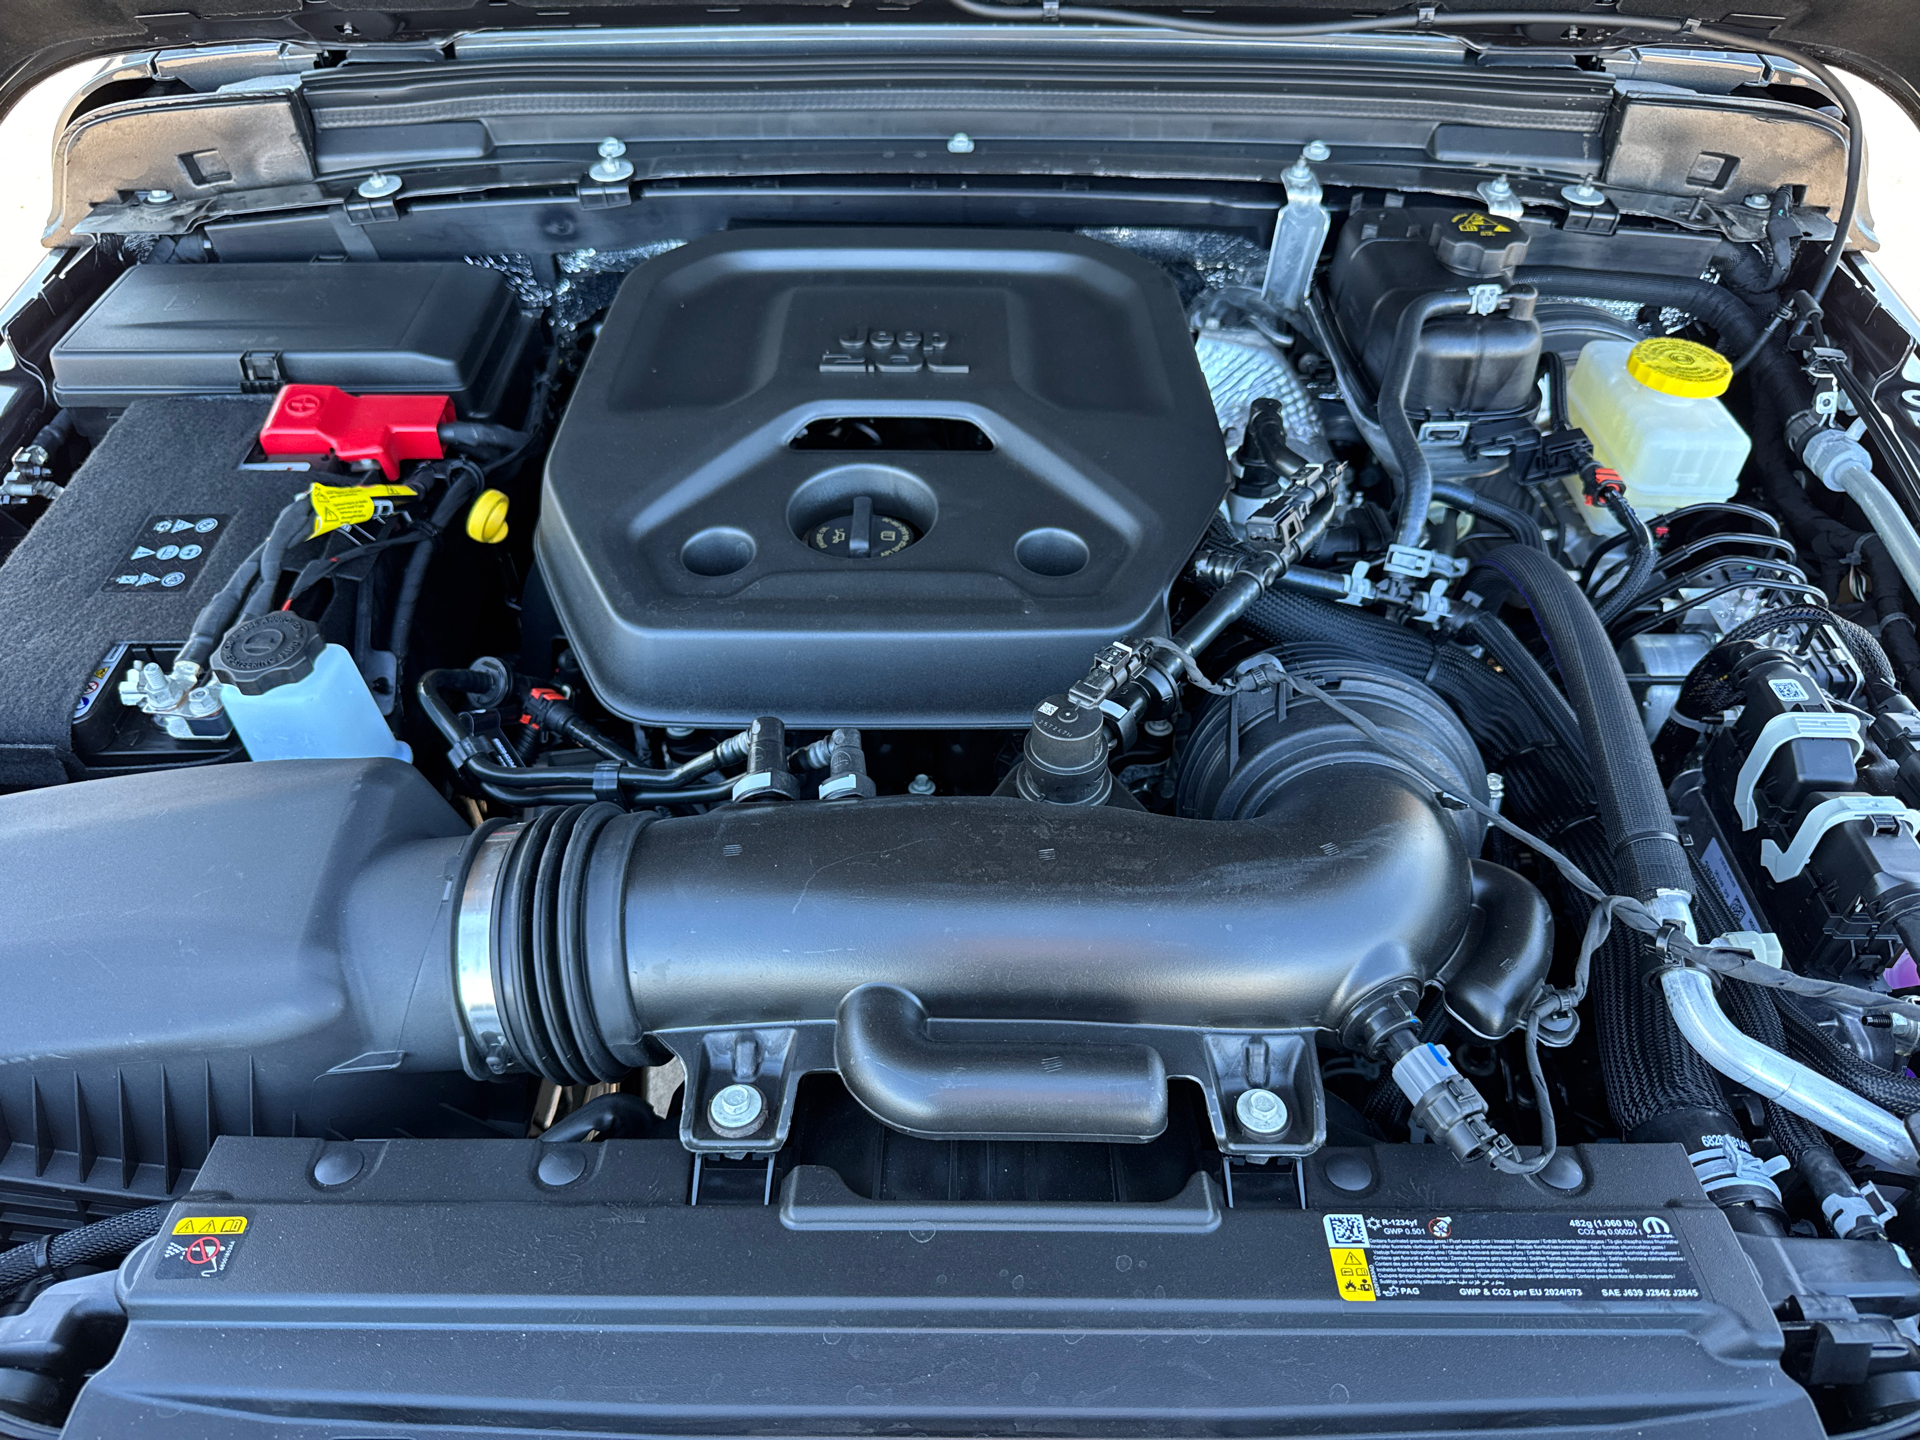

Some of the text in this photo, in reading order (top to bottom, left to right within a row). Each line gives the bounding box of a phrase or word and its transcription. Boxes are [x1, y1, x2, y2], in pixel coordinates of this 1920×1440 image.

[839, 325, 949, 353] Jeep
[819, 350, 970, 373] 2.0L
[262, 615, 303, 631] APPROVED
[1381, 1218, 1418, 1228] R-1234yf
[1569, 1219, 1638, 1229] 482g (1.060 lb)
[1577, 1228, 1595, 1236] CO2
[1596, 1229, 1608, 1237] eq
[1608, 1228, 1638, 1236] 0.00024
[1400, 1287, 1420, 1295] PAG
[1459, 1288, 1481, 1296] GWP
[1483, 1288, 1491, 1296] &
[1492, 1288, 1511, 1296] CO2
[1513, 1289, 1528, 1298] per
[1544, 1288, 1583, 1297] 2024/573
[1601, 1288, 1699, 1297] SAE J639 J2842 J2845
